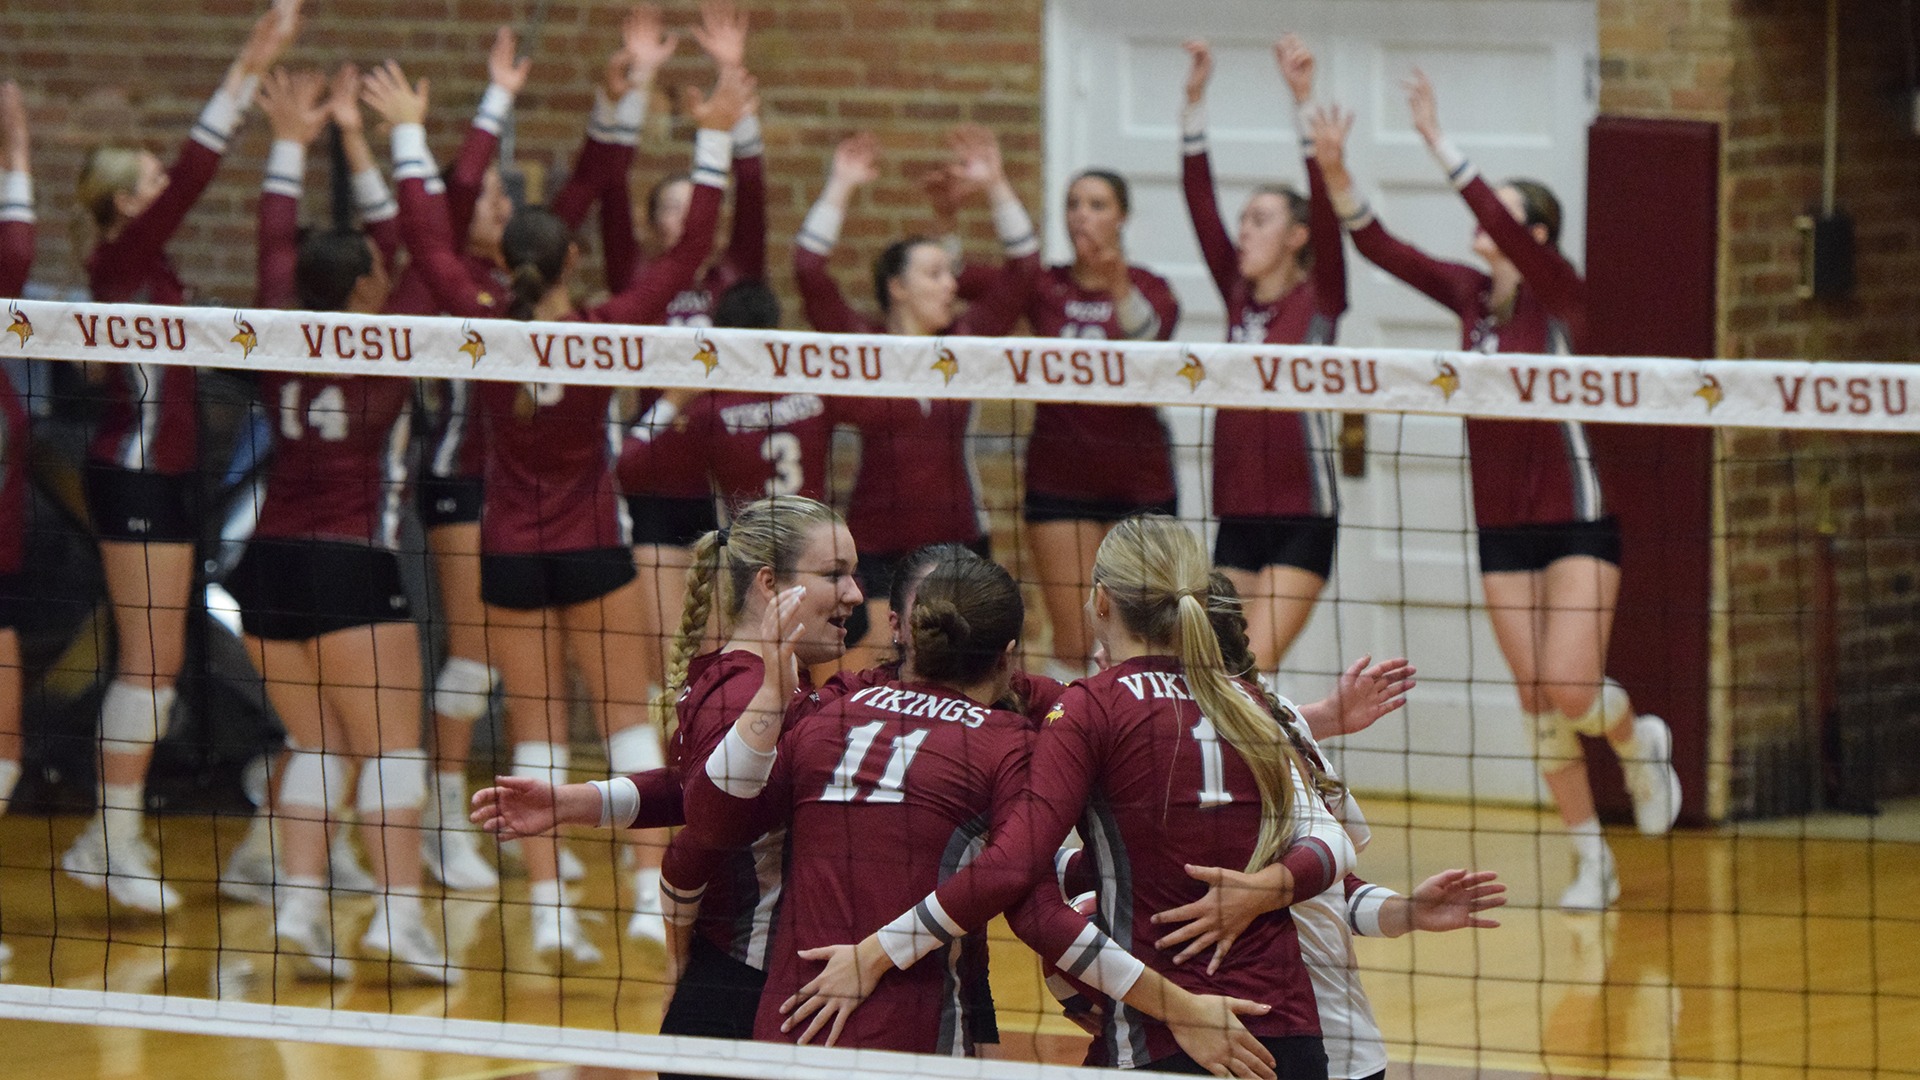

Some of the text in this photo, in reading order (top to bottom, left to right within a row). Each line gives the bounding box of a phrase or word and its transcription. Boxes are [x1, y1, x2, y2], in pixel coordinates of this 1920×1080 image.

[74, 313, 187, 351] VCSU
[302, 323, 413, 362] VCSU
[530, 333, 645, 371] VCSU
[765, 342, 882, 380] VCSU
[1005, 349, 1126, 386] VCSU
[1253, 356, 1379, 394] VCSU
[1510, 368, 1639, 407] VCSU
[280, 380, 348, 441] 14
[1775, 376, 1908, 415] VCSU
[760, 433, 803, 496] 3
[850, 685, 991, 728] VIKINGS
[820, 719, 931, 803] 11
[1190, 715, 1234, 809] 1
